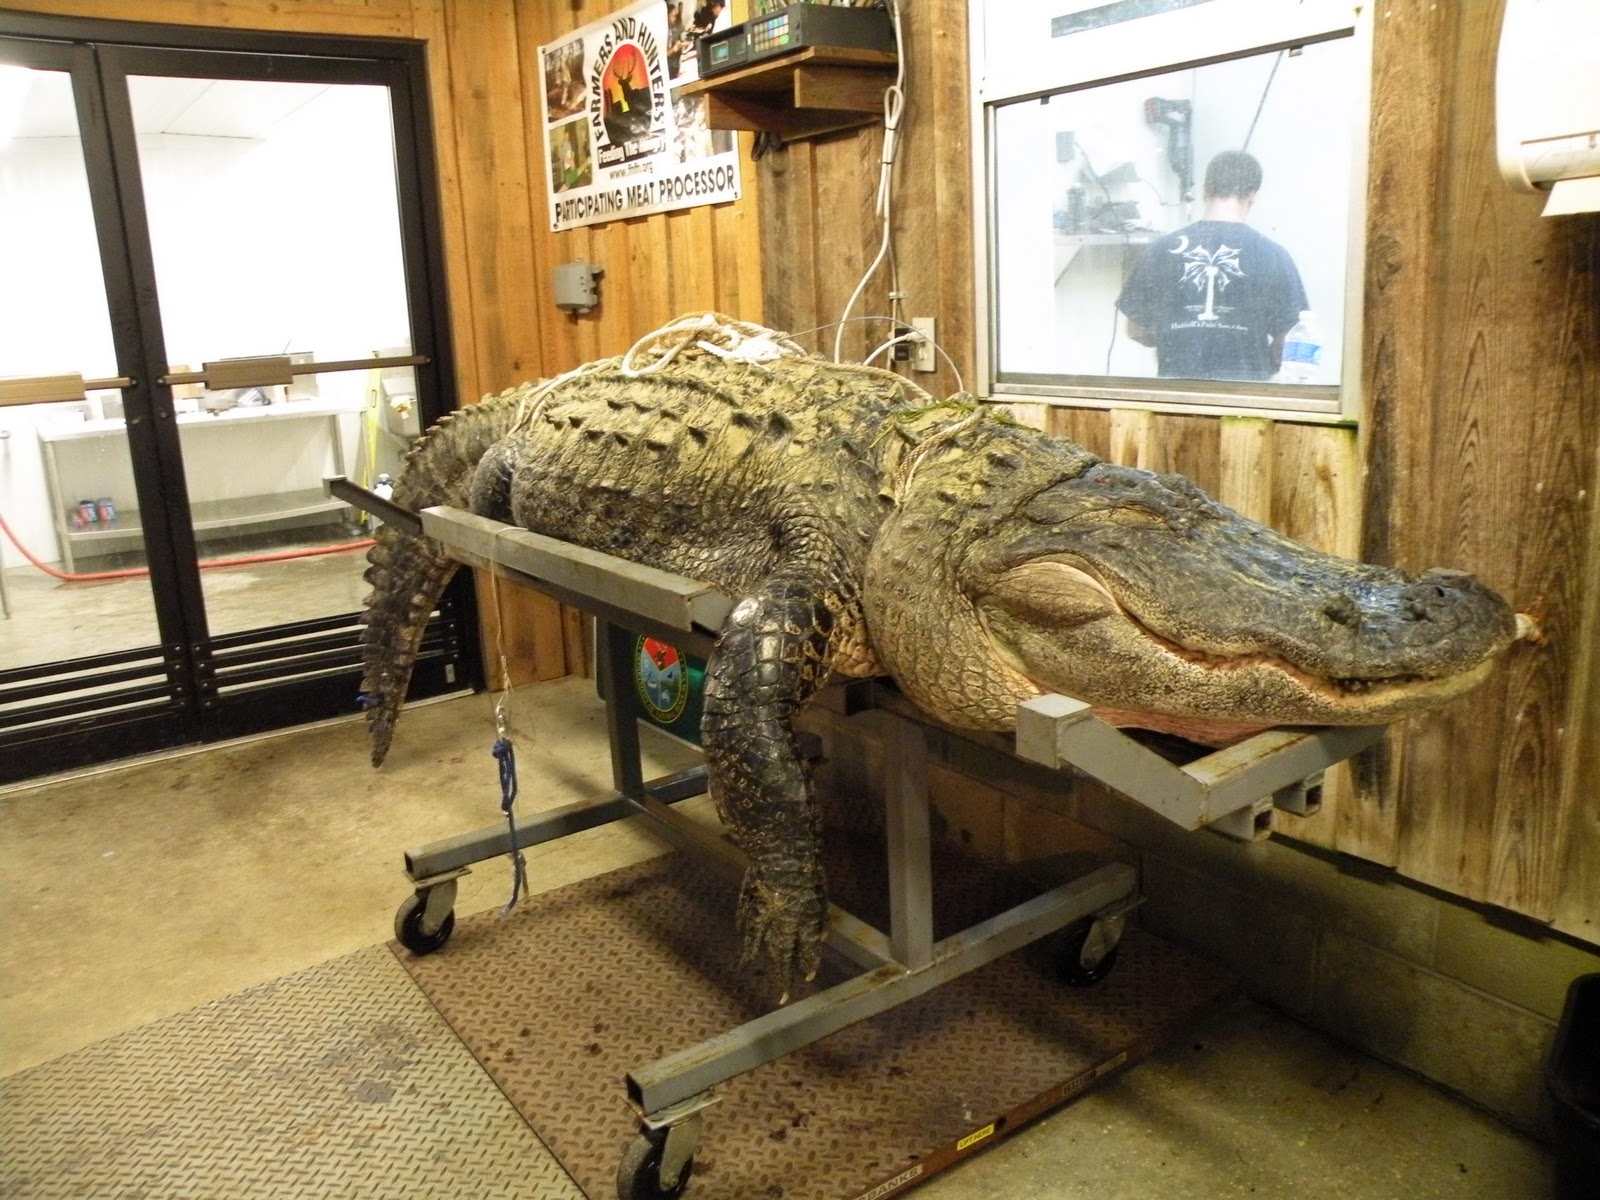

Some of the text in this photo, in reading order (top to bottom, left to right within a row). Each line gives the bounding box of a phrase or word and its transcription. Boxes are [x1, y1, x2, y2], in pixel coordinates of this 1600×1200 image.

[591, 33, 613, 142] FARMERS
[612, 17, 636, 45] AND
[637, 22, 664, 124] HUNTERS
[555, 165, 735, 223] PARTICIPATING MEAT PROCESSOR
[858, 1167, 919, 1200] BANKS
